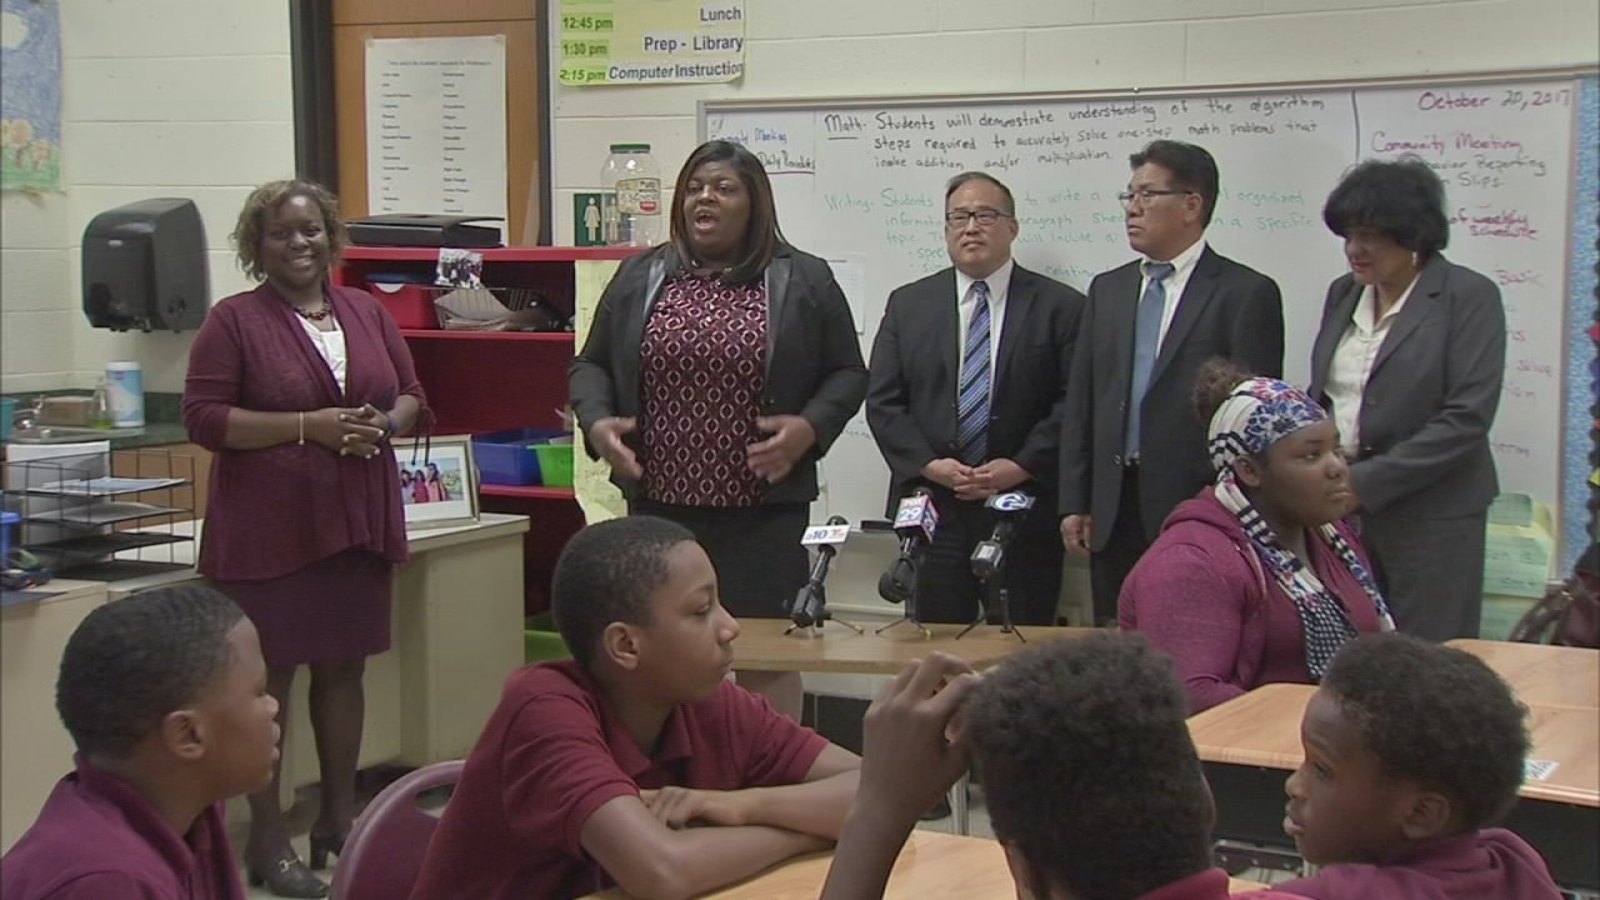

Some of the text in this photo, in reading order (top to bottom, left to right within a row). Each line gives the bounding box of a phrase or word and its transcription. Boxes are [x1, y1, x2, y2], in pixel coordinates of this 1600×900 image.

[700, 7, 741, 21] Lunch
[563, 17, 613, 31] 12:45 pm
[563, 44, 607, 57] 1:30 pm
[644, 36, 677, 53] Prep
[693, 36, 744, 52] Library
[560, 69, 606, 82] 2:15 pm
[609, 65, 674, 84] Computer
[1419, 92, 1490, 110] October
[876, 111, 936, 130] Students
[947, 114, 972, 128] will
[1069, 102, 1157, 122] understanding
[1171, 100, 1188, 114] of
[1209, 98, 1233, 113] the
[1250, 95, 1325, 116] algorithm
[875, 138, 911, 152] steps
[925, 137, 976, 153] required
[994, 135, 1006, 147] to
[1188, 123, 1220, 135] math
[1286, 120, 1317, 132] that
[1371, 131, 1523, 155] Community Meeting
[916, 156, 964, 170] addition
[880, 187, 934, 208] Students
[900, 507, 921, 520] 29
